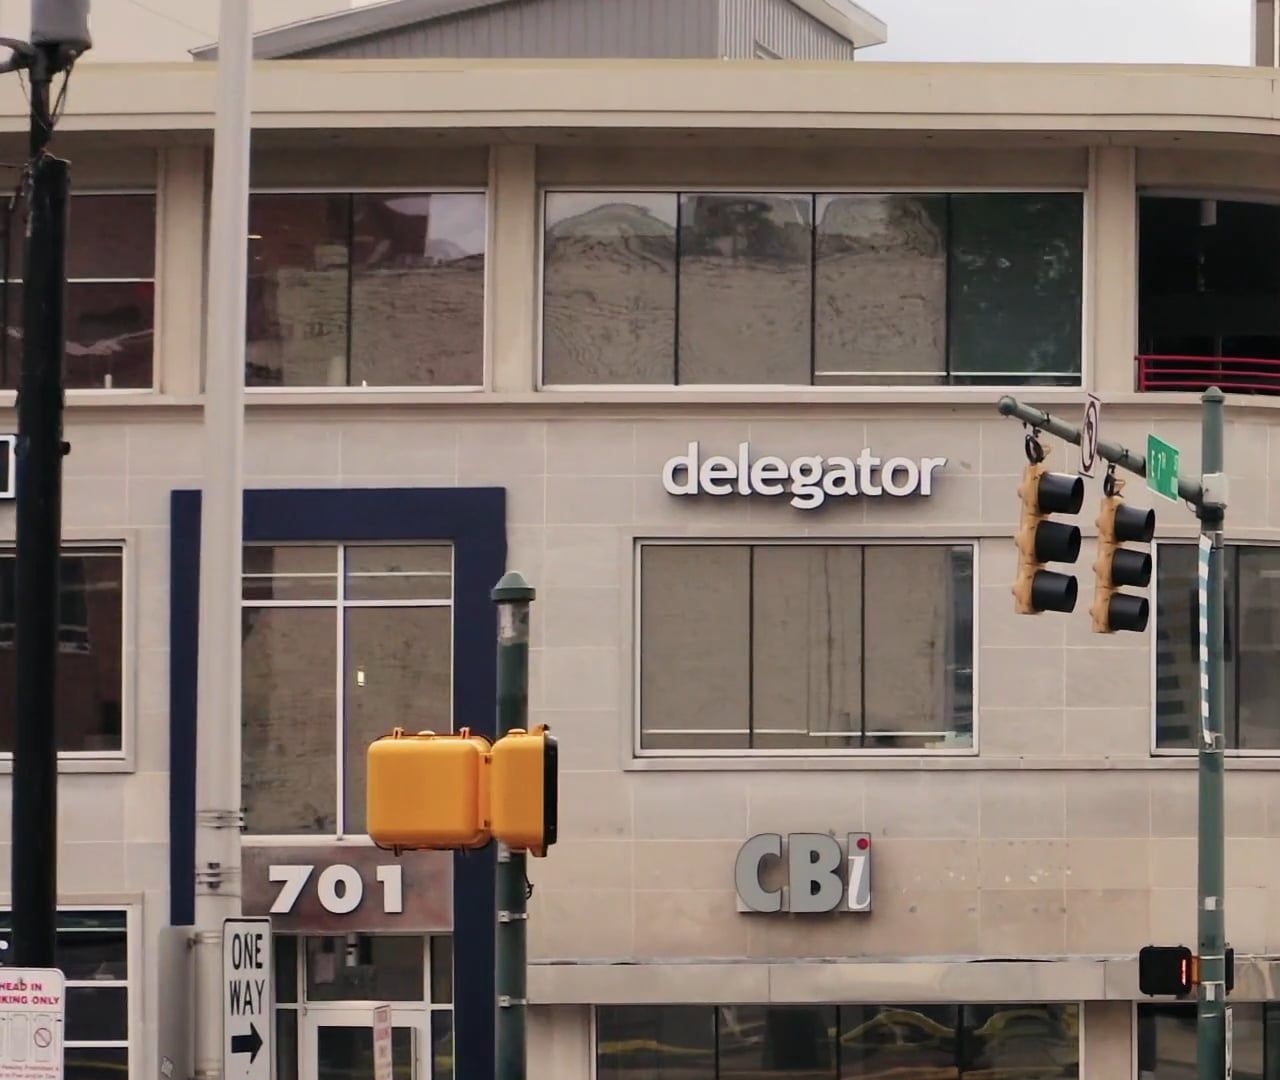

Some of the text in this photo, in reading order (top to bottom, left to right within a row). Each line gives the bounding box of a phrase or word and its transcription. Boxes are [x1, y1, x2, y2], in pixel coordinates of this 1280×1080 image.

[661, 441, 948, 510] delegator
[269, 864, 402, 914] 701
[735, 832, 872, 913] CBi
[232, 933, 263, 970] ONE
[0, 996, 60, 1005] KING ONLY
[31, 983, 42, 991] IN
[229, 980, 265, 1016] WAY
